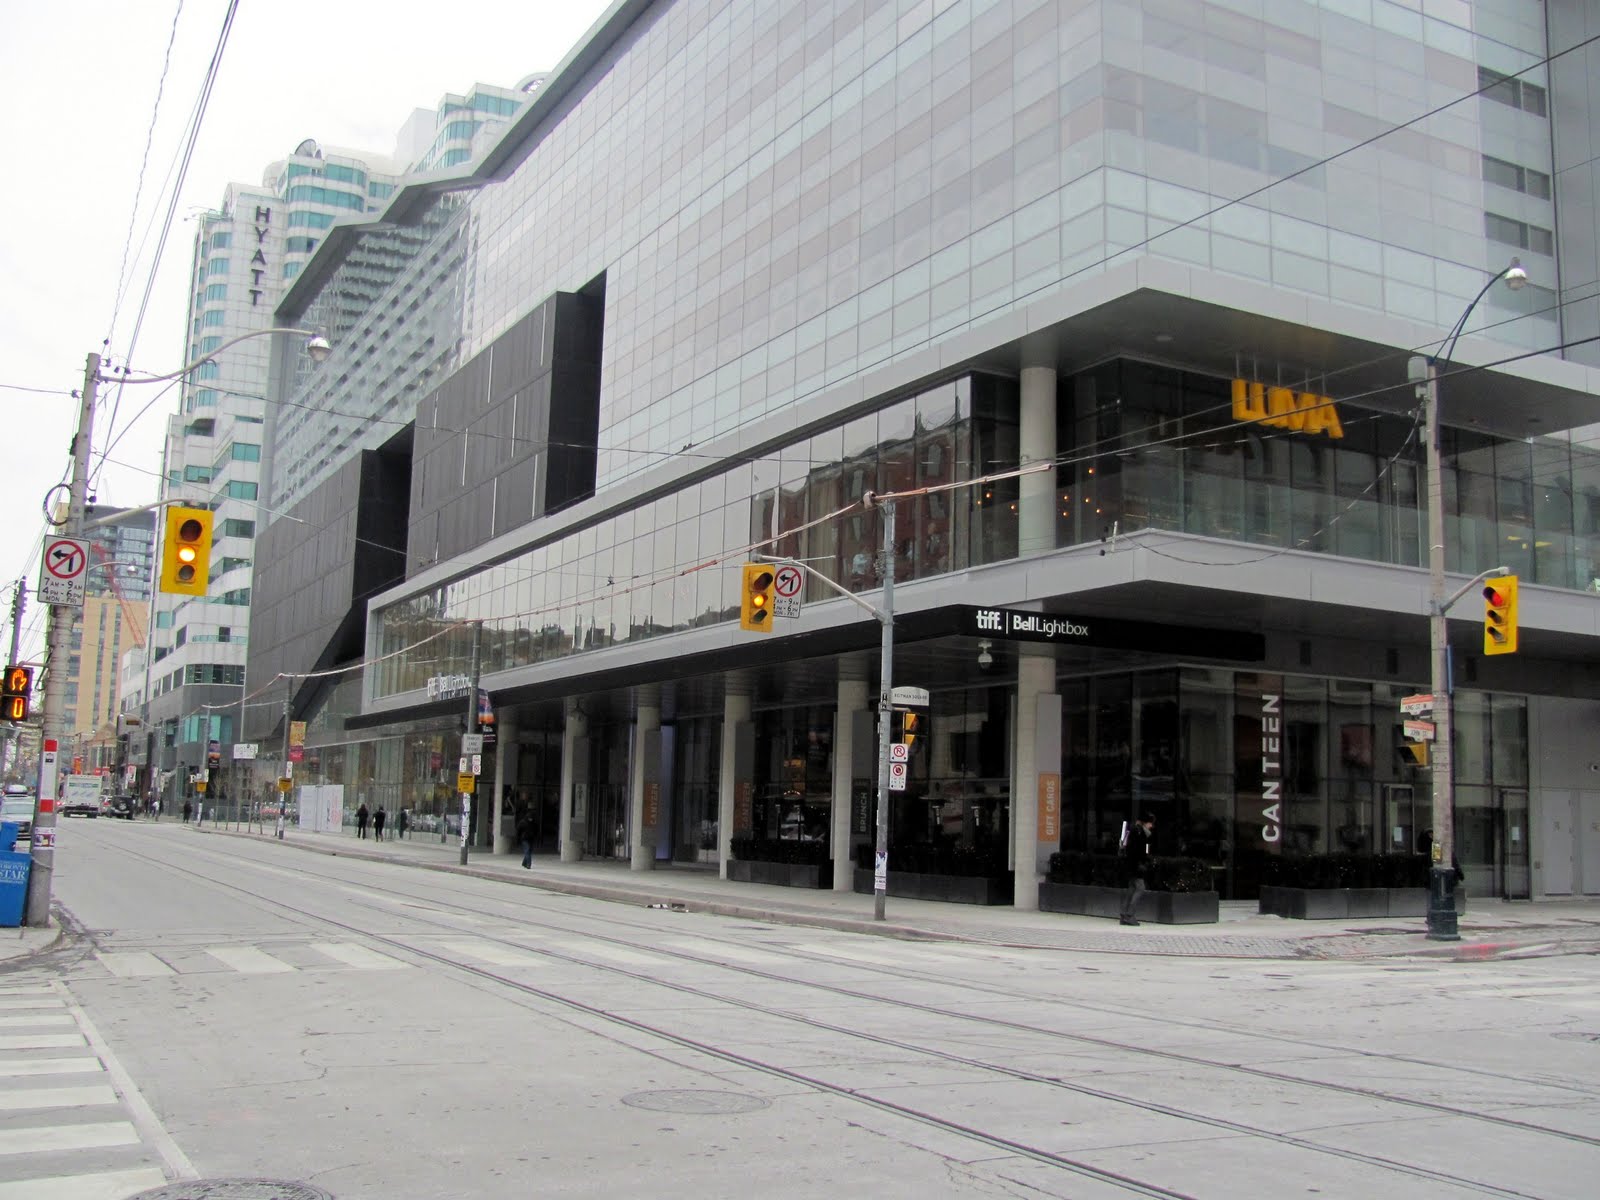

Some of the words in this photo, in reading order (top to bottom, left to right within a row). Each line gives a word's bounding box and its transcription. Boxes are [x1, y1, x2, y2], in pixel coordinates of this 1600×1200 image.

[249, 206, 271, 306] HYATT
[1231, 379, 1344, 439] LUMA
[1262, 694, 1280, 842] CANTEEN
[860, 792, 868, 832] BRUNCH
[1046, 780, 1056, 812] CARDS
[1046, 815, 1055, 836] GIFT
